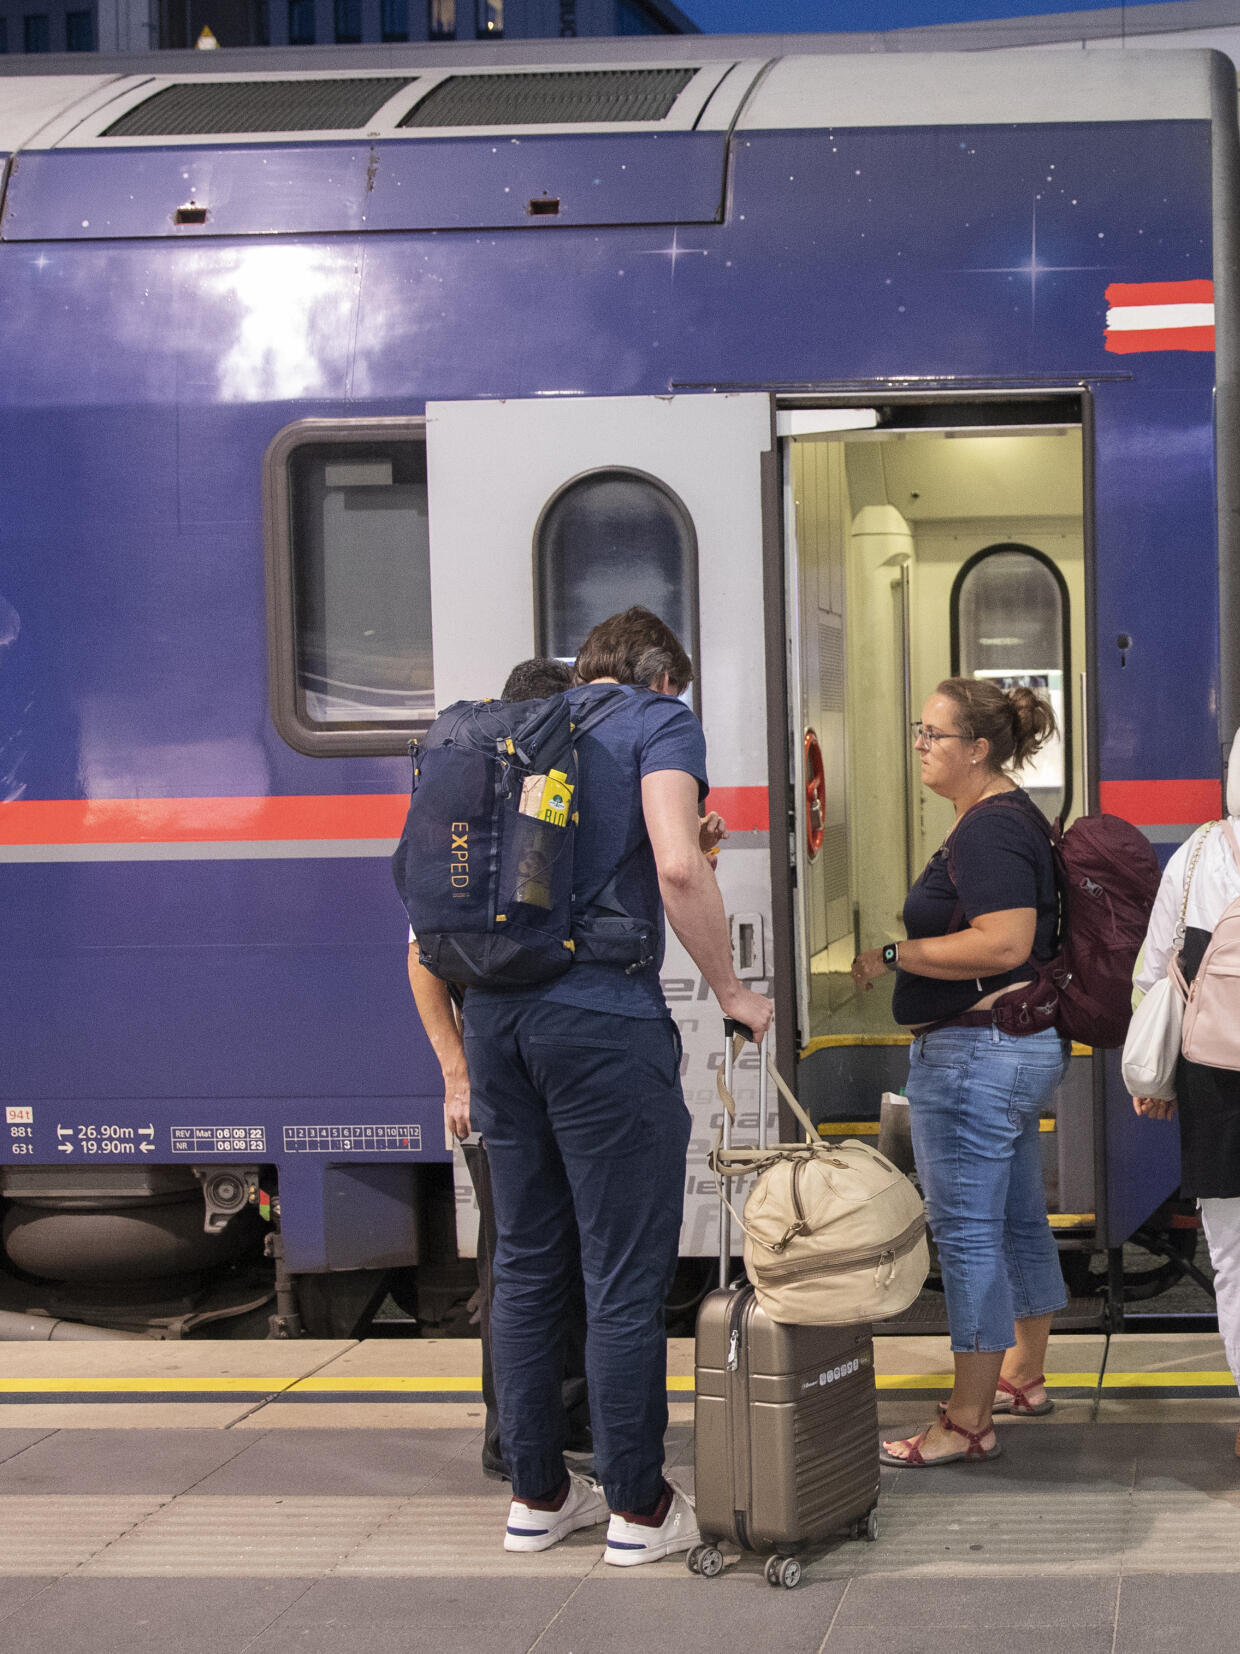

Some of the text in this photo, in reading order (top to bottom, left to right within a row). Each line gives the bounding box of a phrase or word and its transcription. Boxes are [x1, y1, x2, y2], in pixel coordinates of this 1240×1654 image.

[450, 822, 469, 888] EXPED
[77, 1125, 134, 1139] 26.90m
[175, 1129, 191, 1138] REV
[216, 1129, 230, 1139] 06
[233, 1128, 246, 1138] 09
[249, 1129, 262, 1139] 22
[80, 1140, 135, 1154] 19.90m
[176, 1140, 263, 1151] NR 06 09 23
[343, 1140, 351, 1149] 3
